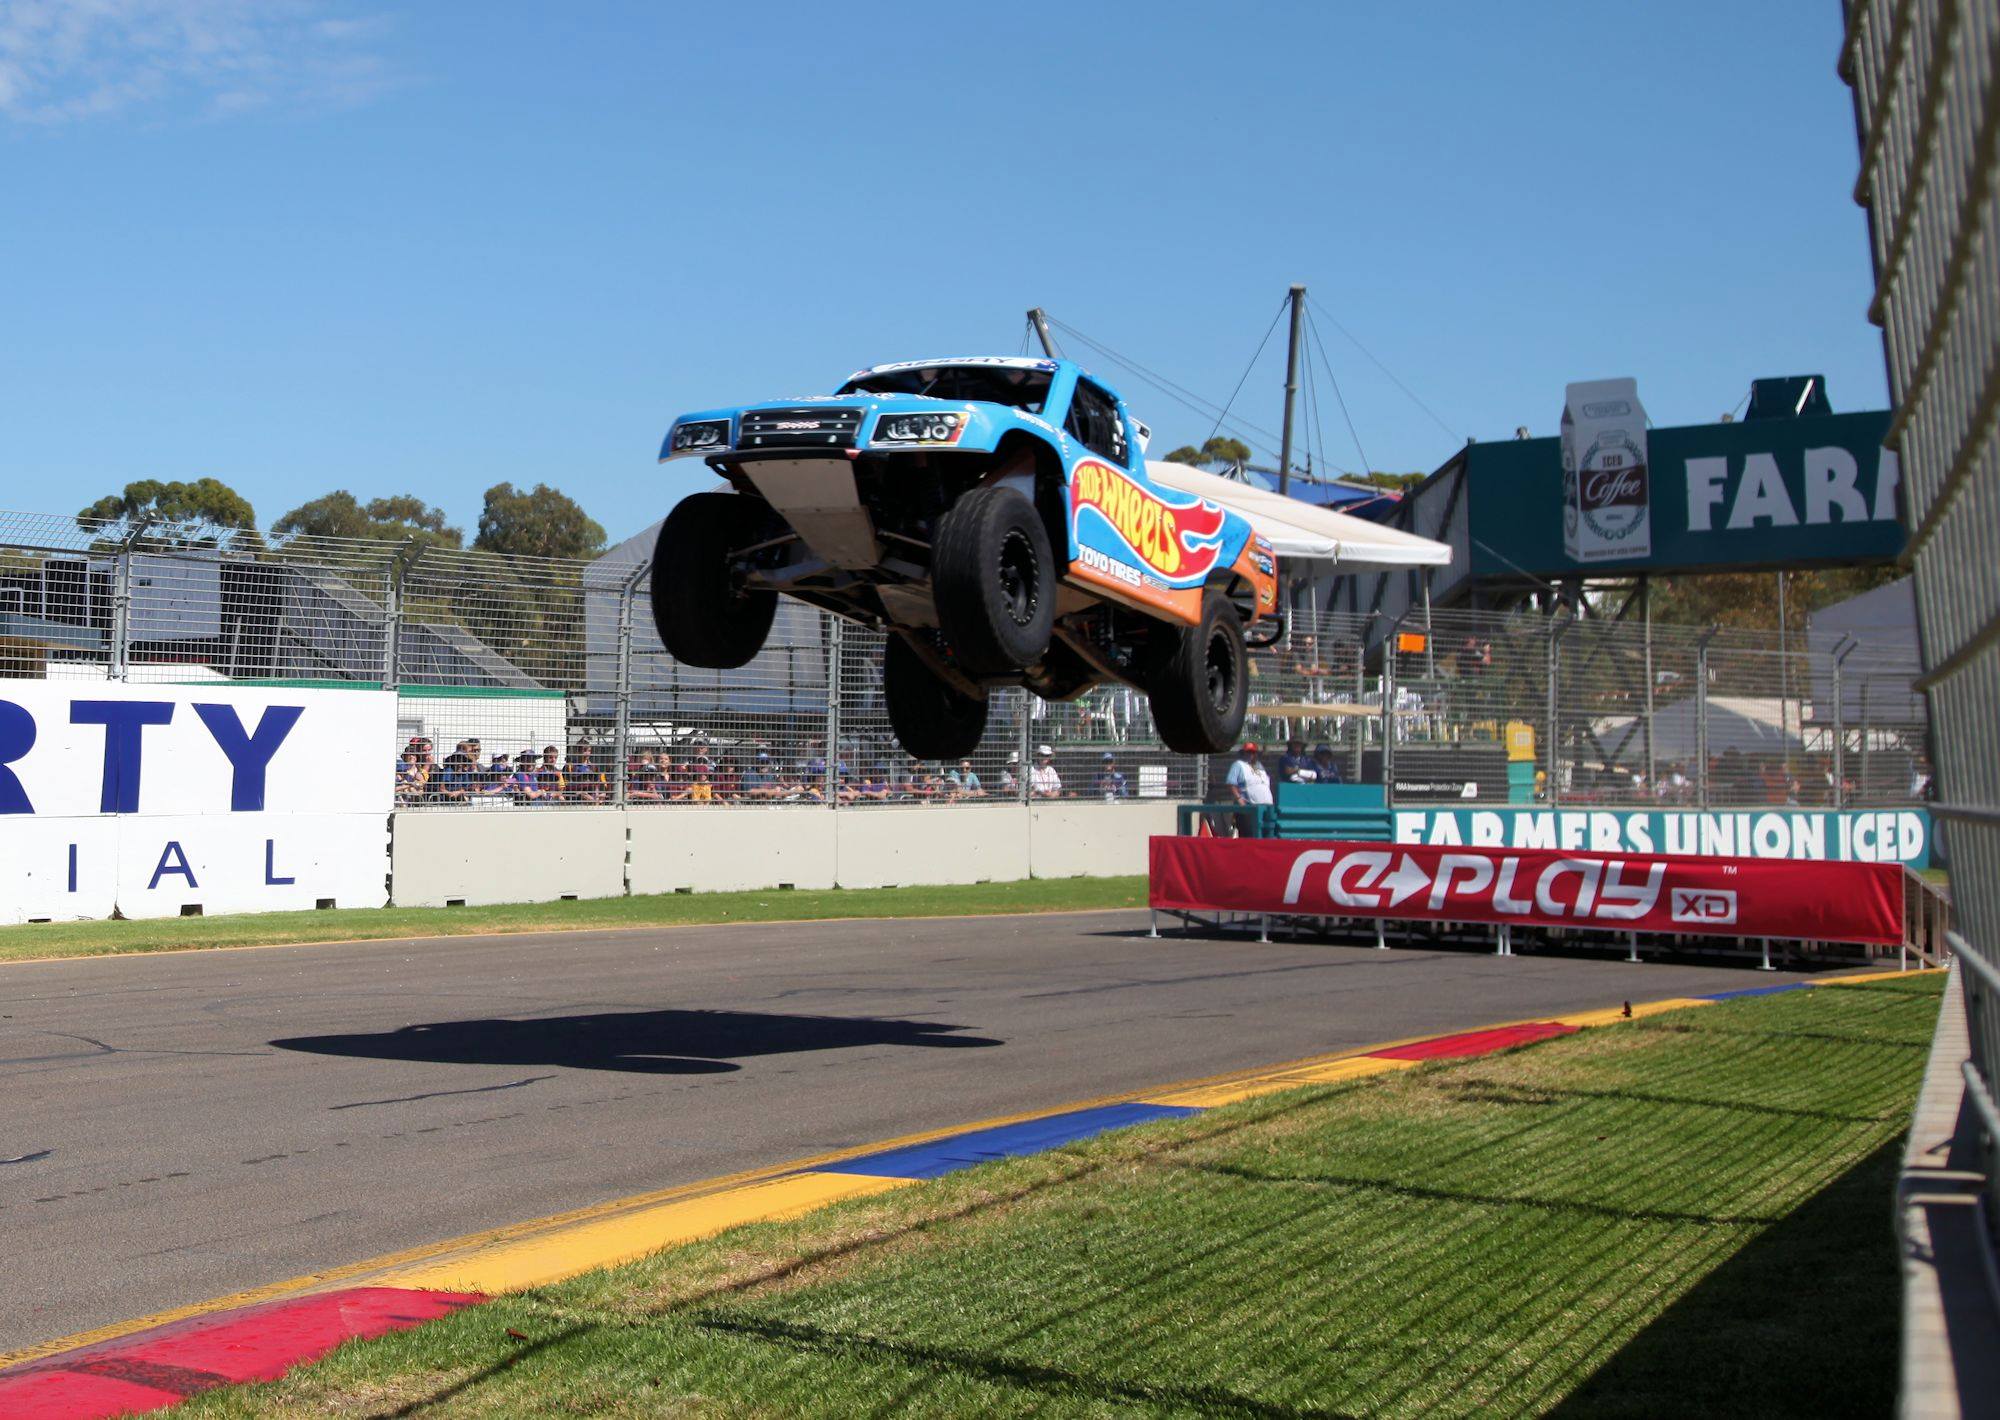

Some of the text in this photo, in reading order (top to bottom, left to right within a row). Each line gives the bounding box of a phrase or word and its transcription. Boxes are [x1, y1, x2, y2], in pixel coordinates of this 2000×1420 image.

[1585, 469, 1642, 506] Coffee
[1684, 444, 1899, 532] FAR
[1078, 543, 1108, 573] TOYO
[1108, 557, 1141, 588] TIRES
[1396, 811, 1655, 854] FARMERS
[1664, 811, 1826, 861] UNION
[1837, 811, 1924, 861] ICED
[1678, 893, 1731, 918] XD
